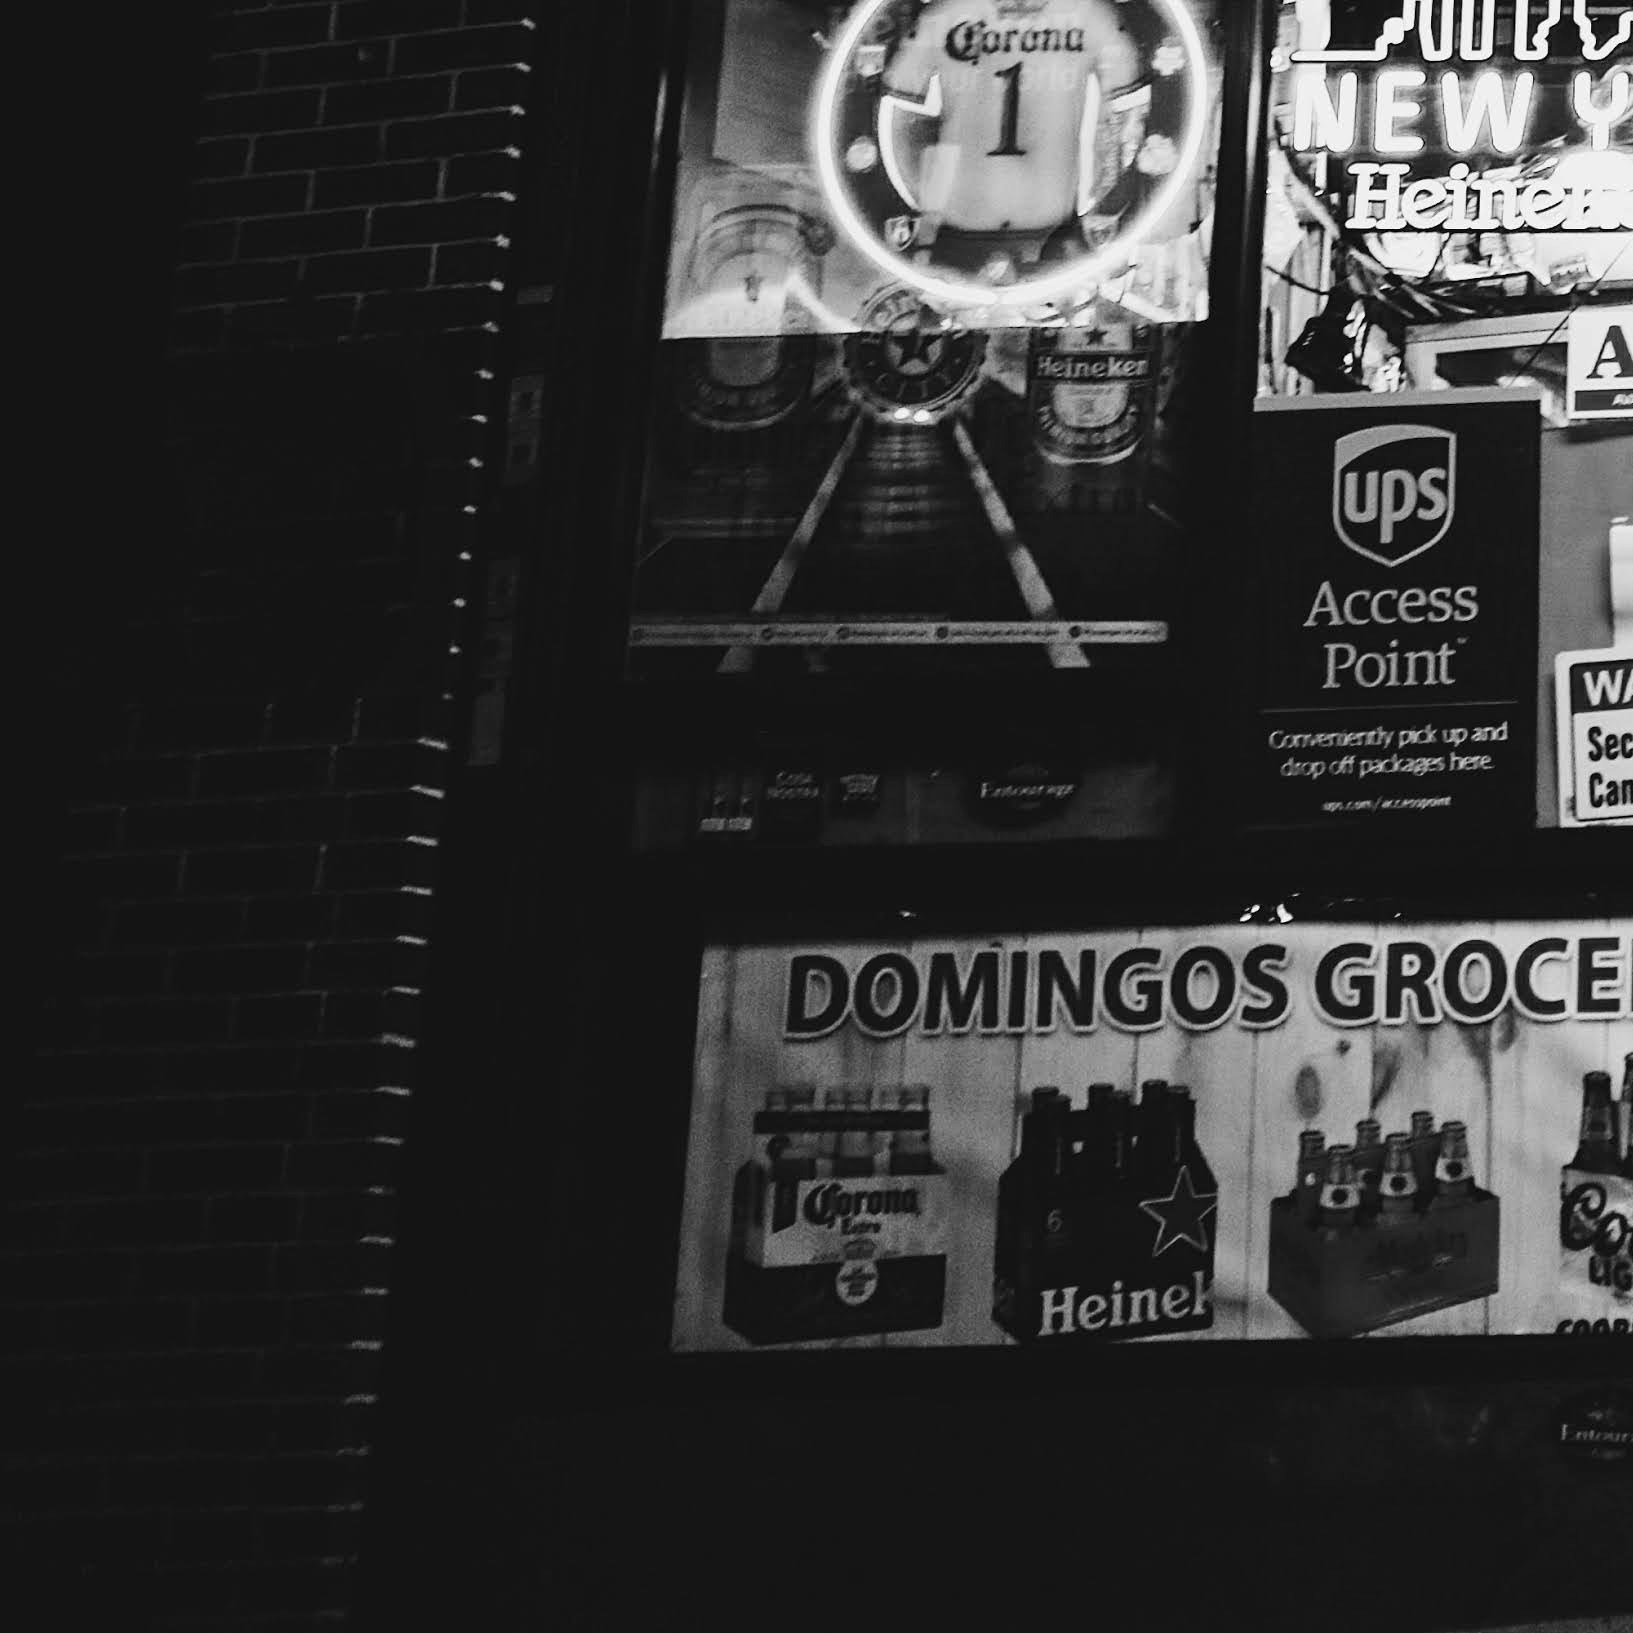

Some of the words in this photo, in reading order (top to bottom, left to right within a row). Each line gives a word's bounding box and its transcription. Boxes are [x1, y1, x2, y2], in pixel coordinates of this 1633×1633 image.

[944, 18, 1086, 66] Corona
[1292, 71, 1535, 153] NEW
[1344, 466, 1450, 545] ups
[1303, 580, 1480, 629] Access
[1321, 642, 1457, 690] Point
[1268, 725, 1395, 750] Conveniently
[1398, 723, 1439, 749] pick
[1442, 726, 1469, 748] up
[1471, 720, 1509, 742] and
[1280, 756, 1327, 780] drop
[1329, 755, 1357, 776] off
[1358, 753, 1446, 780] packages
[783, 944, 1291, 1041] DOMINGOS
[803, 1182, 922, 1229] Corona
